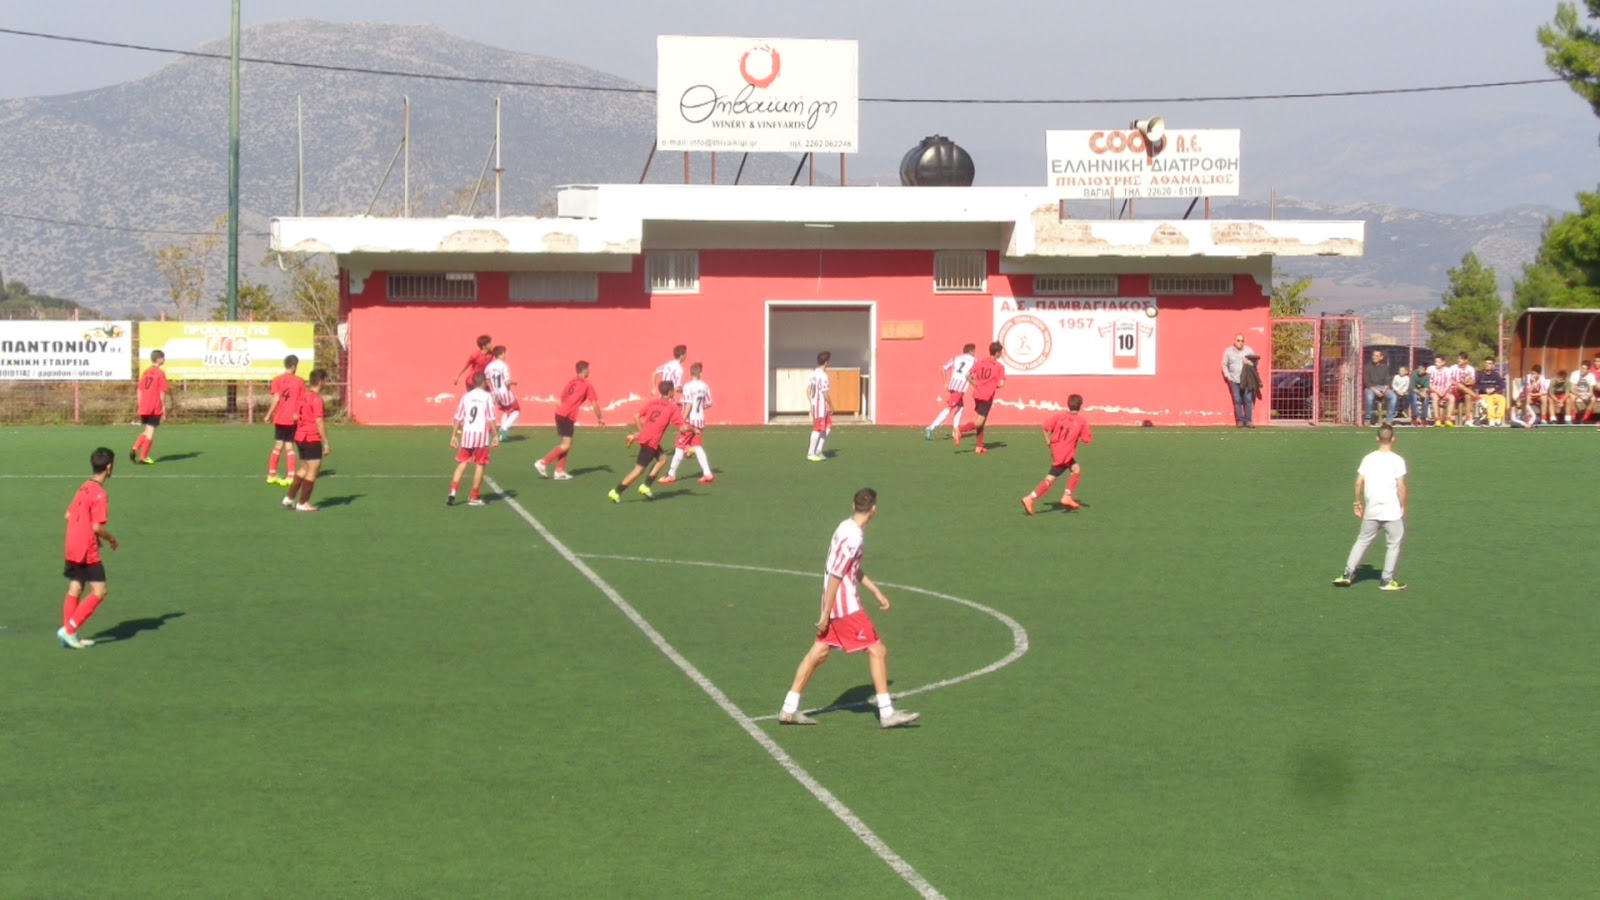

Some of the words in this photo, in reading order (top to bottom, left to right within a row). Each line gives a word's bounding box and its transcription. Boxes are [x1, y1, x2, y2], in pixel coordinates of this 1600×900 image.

[712, 120, 746, 129] WINERY
[749, 121, 755, 129] &
[757, 120, 806, 129] VINEYARDS
[1088, 131, 1168, 154] COO
[1051, 159, 1143, 174] ΕΛΛΗΝΙΚΗ
[1150, 157, 1239, 173] ΔΙΑΤΡΟΦΗ
[1055, 175, 1142, 187] ΠΗΛΙΟΥΡΗΣ
[1150, 174, 1234, 186] ΑΘΑΝΑΣΙΟΣ
[1083, 188, 1110, 197] ΒΑΓΙΑ
[1035, 300, 1152, 312] ΠΑΜΒΑΓΙΑΚΟΣ
[1058, 318, 1094, 329] 1957
[1118, 334, 1134, 350] 10
[43, 358, 90, 367] ΕΤΑΙΡΕΙΑ
[980, 367, 992, 380] 10
[469, 406, 478, 424] 9
